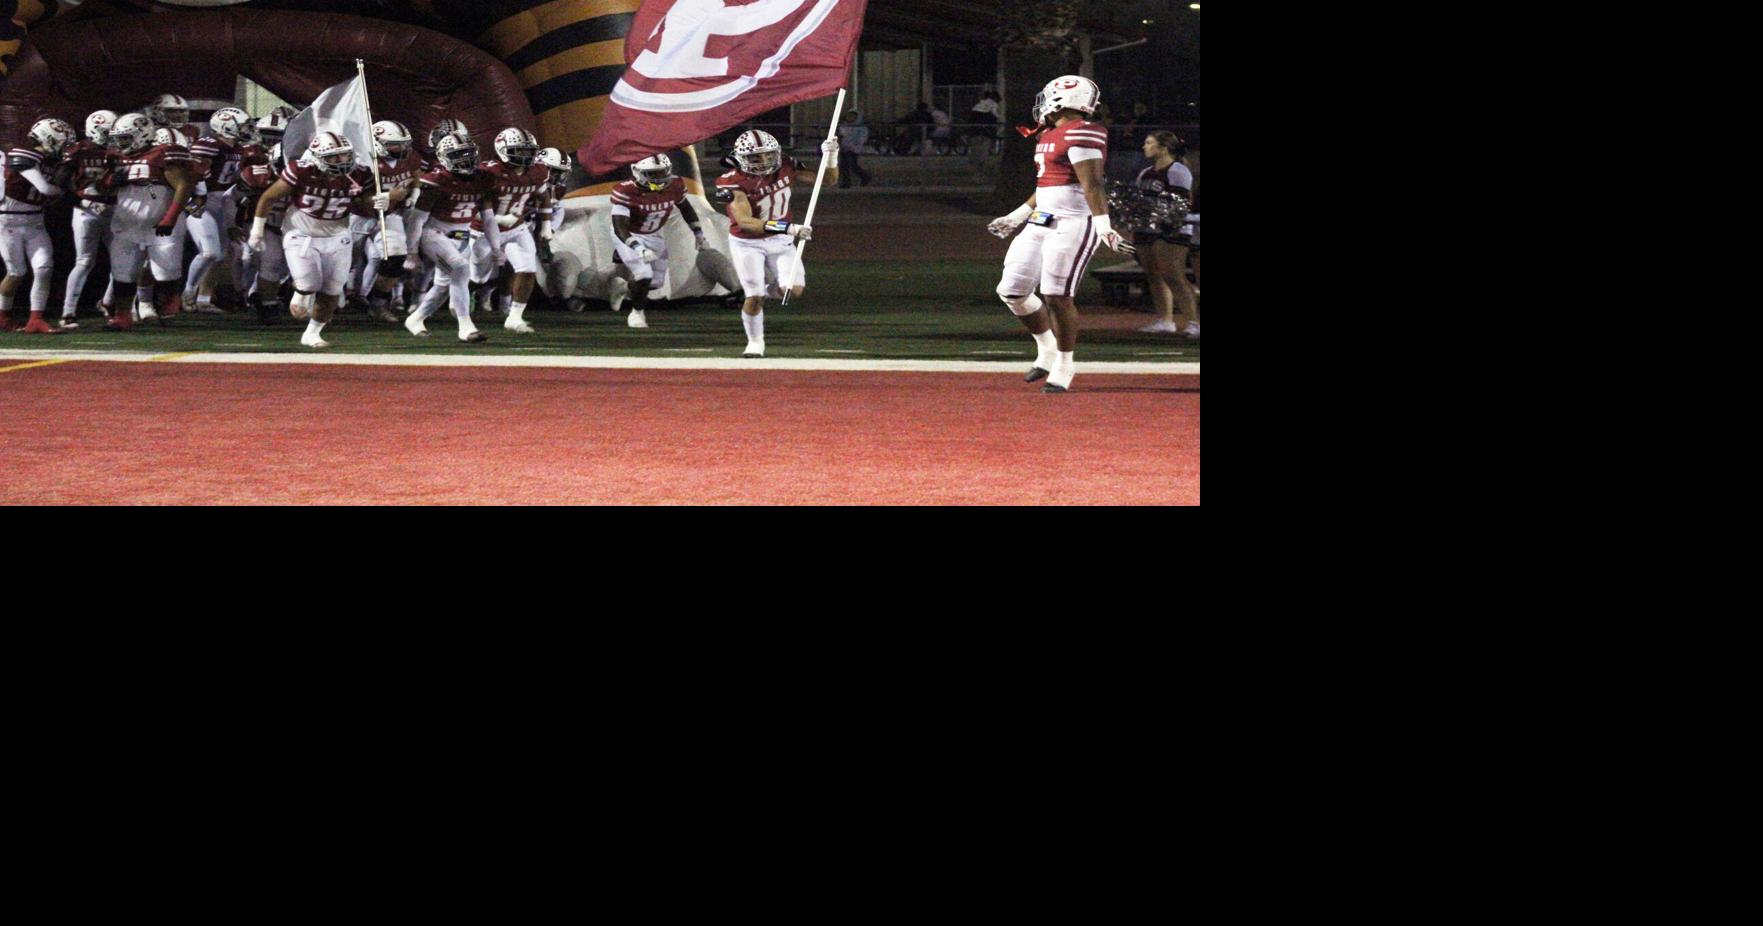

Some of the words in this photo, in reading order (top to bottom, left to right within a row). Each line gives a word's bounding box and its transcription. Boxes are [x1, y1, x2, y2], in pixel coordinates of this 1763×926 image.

[301, 194, 352, 219] 25
[497, 192, 530, 216] 14
[756, 186, 792, 220] 10
